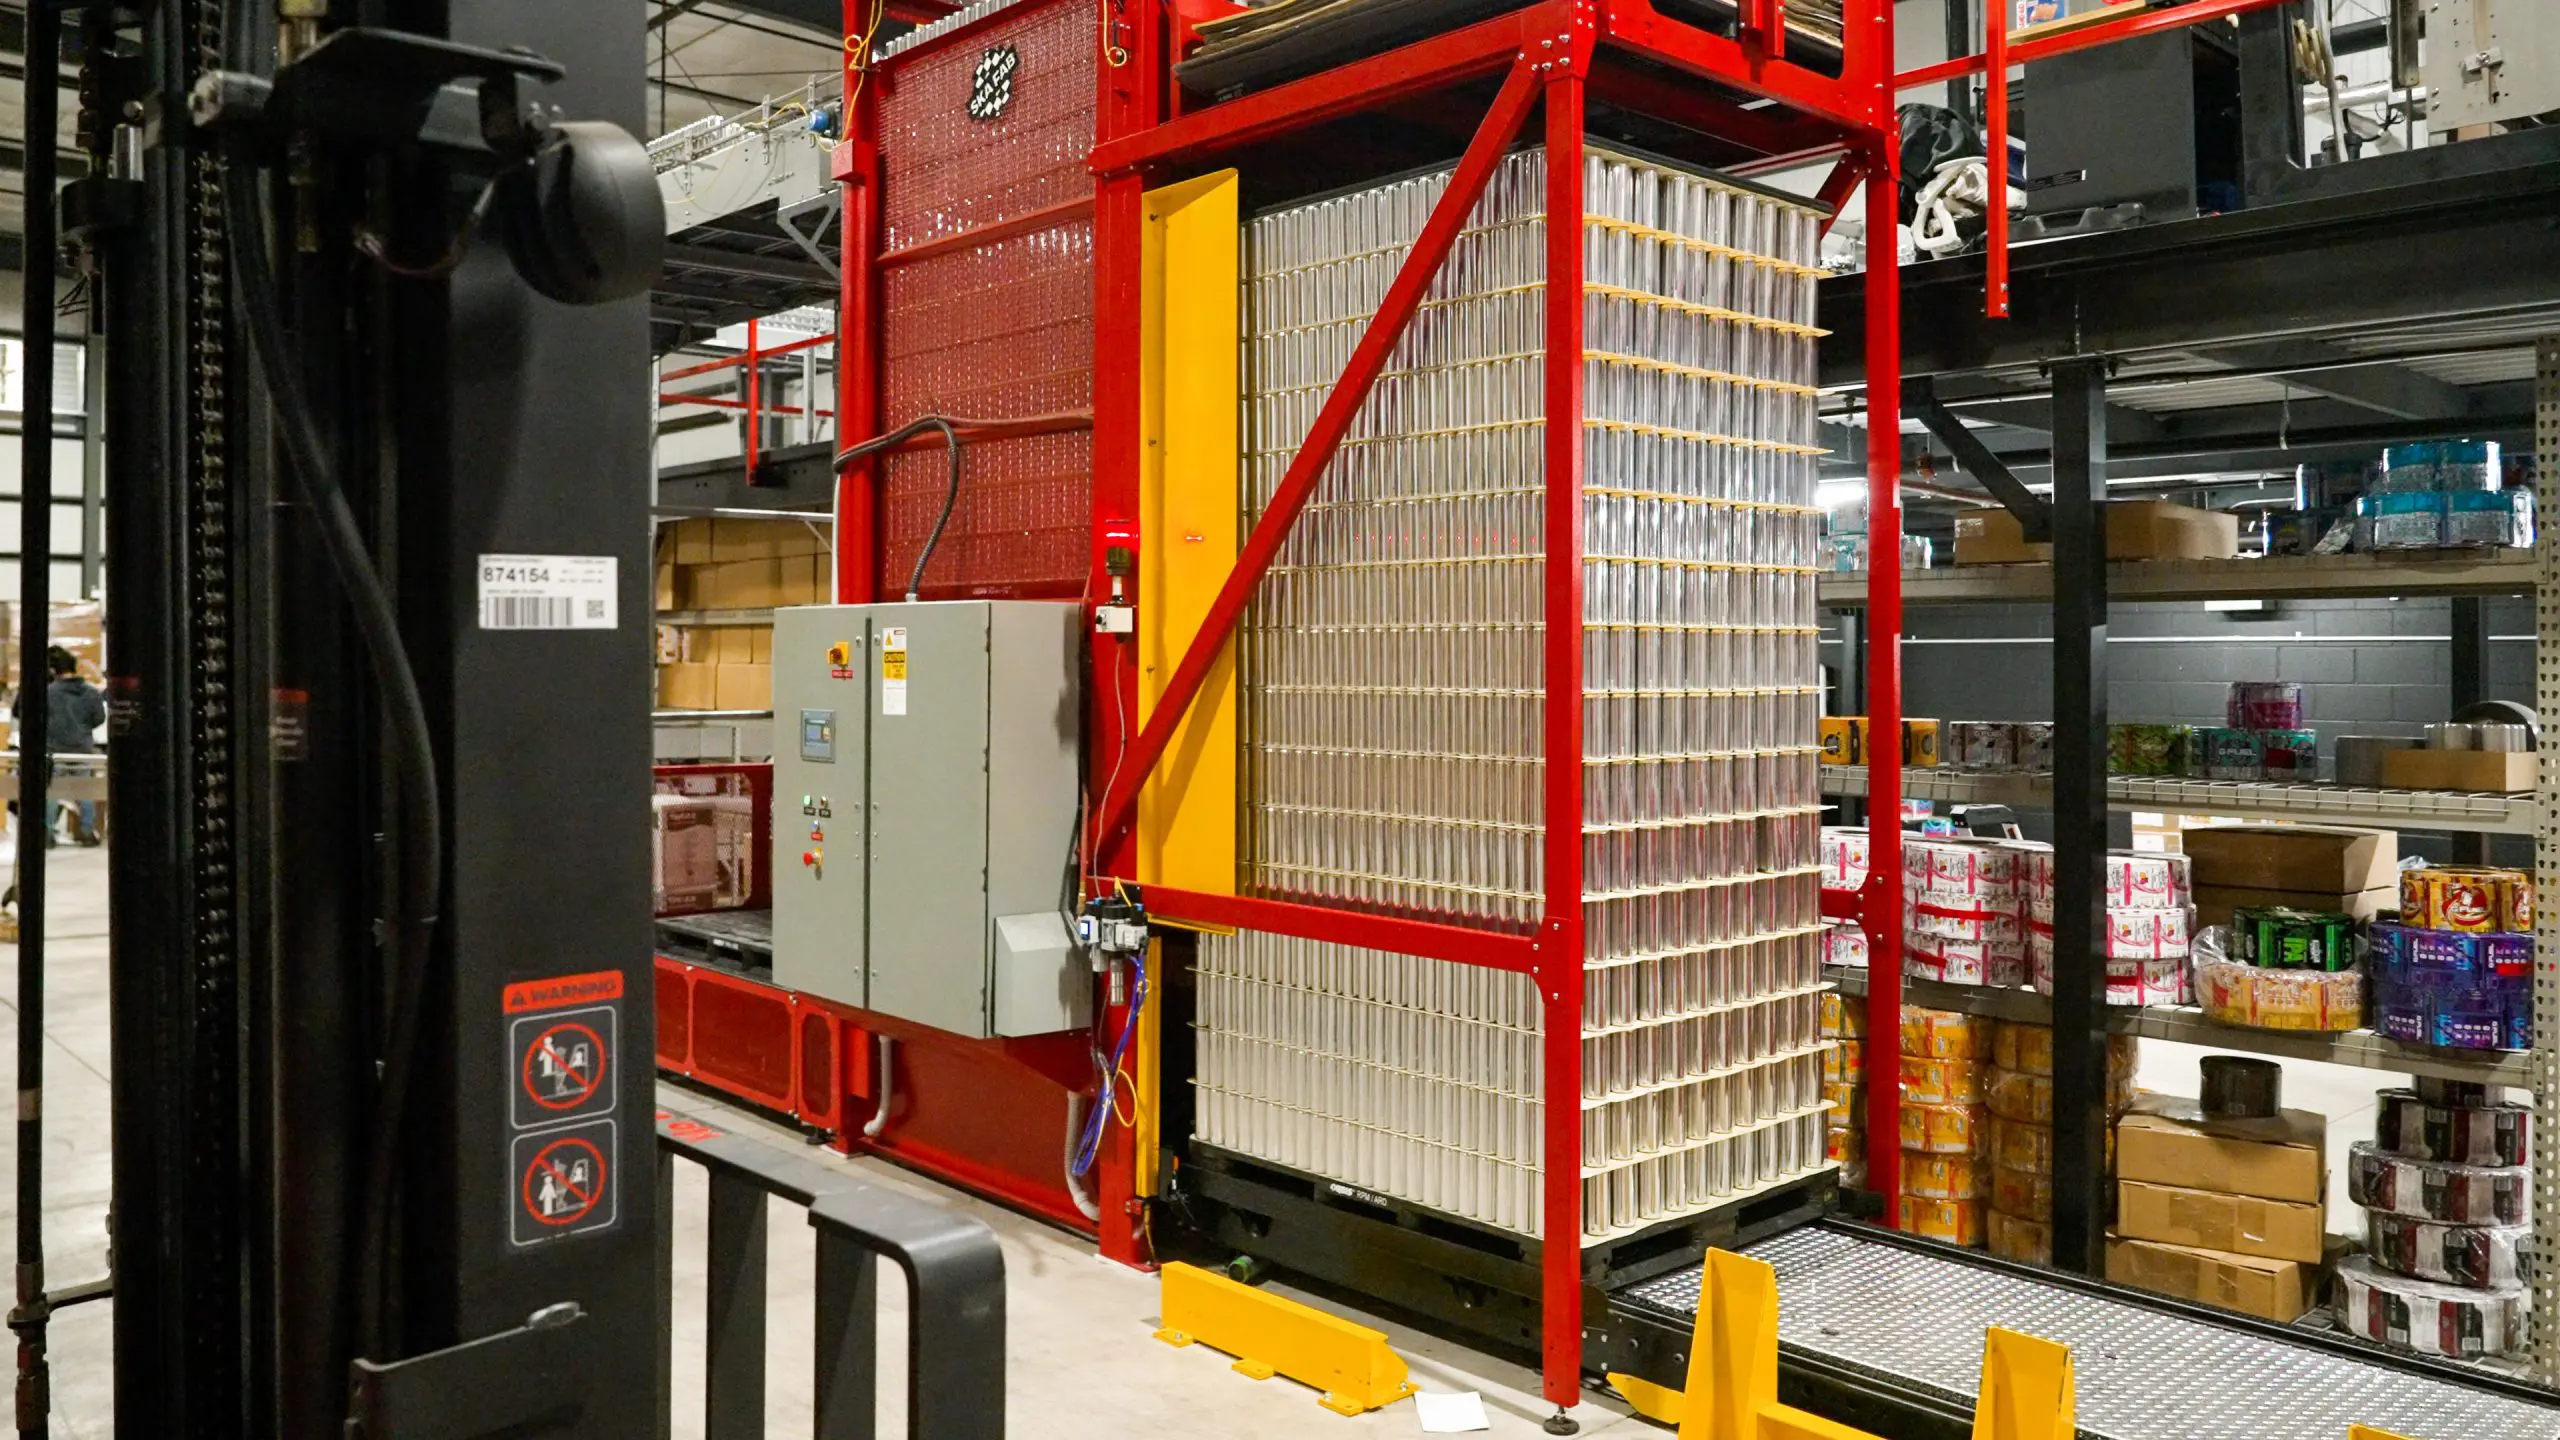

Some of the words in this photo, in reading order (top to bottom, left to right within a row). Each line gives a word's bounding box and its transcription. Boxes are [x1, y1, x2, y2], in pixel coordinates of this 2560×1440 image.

[970, 83, 993, 114] SKA
[992, 53, 1015, 87] FAB
[483, 567, 550, 583] 874154
[531, 979, 617, 1001] WARNING
